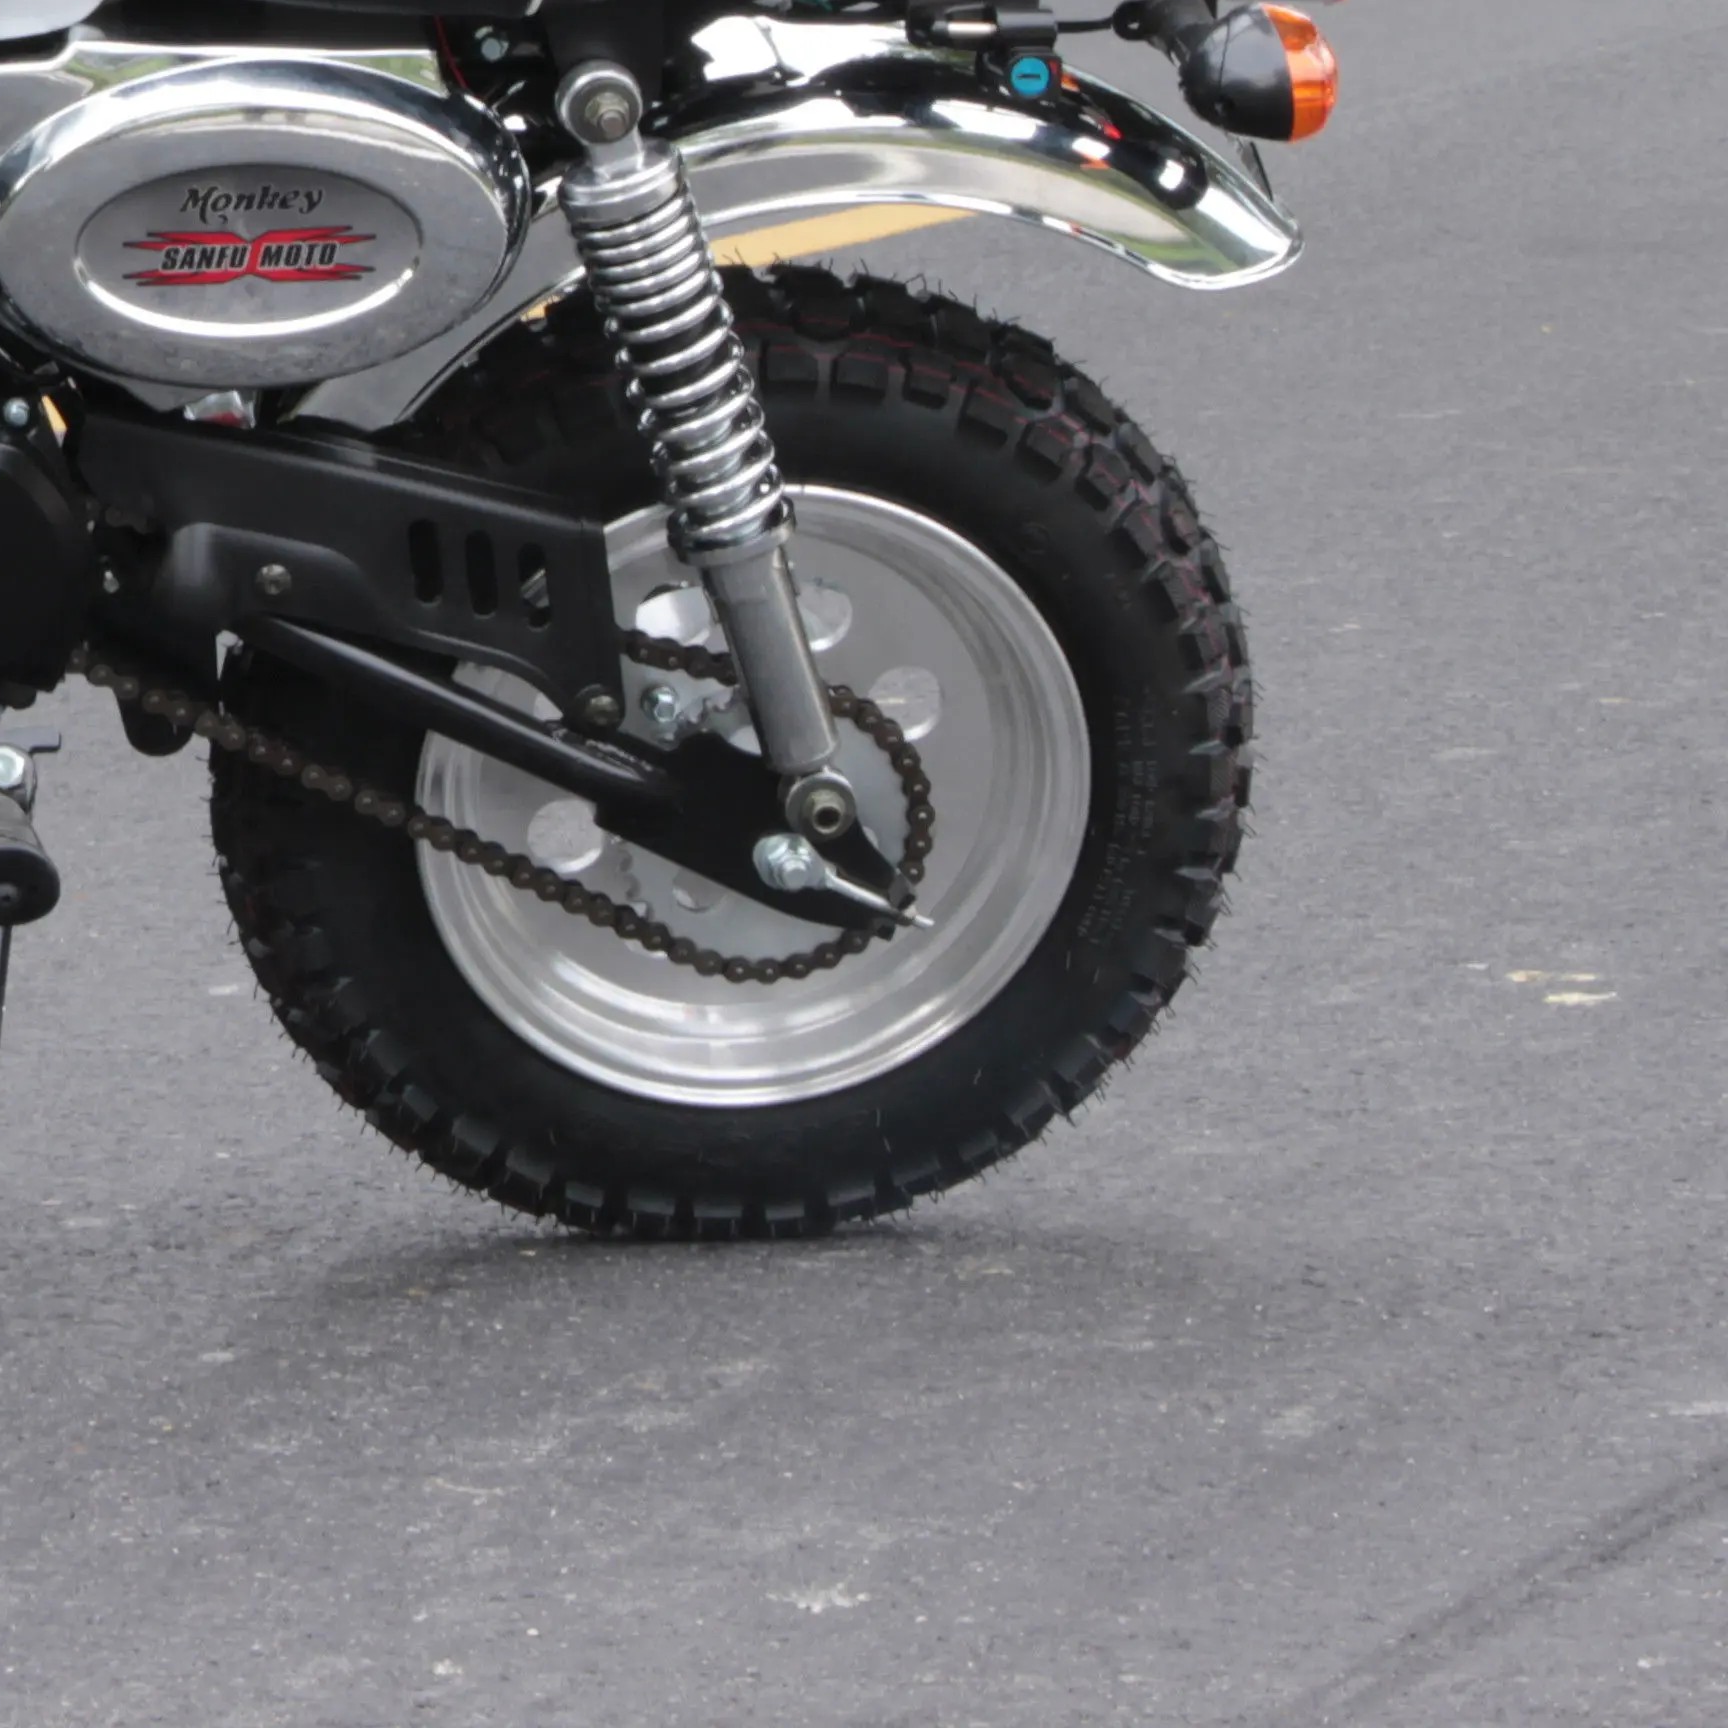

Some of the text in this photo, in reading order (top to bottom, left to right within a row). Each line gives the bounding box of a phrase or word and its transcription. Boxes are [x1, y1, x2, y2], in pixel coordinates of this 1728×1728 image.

[179, 184, 324, 224] Monkey
[160, 242, 338, 271] SANFU MOTO
